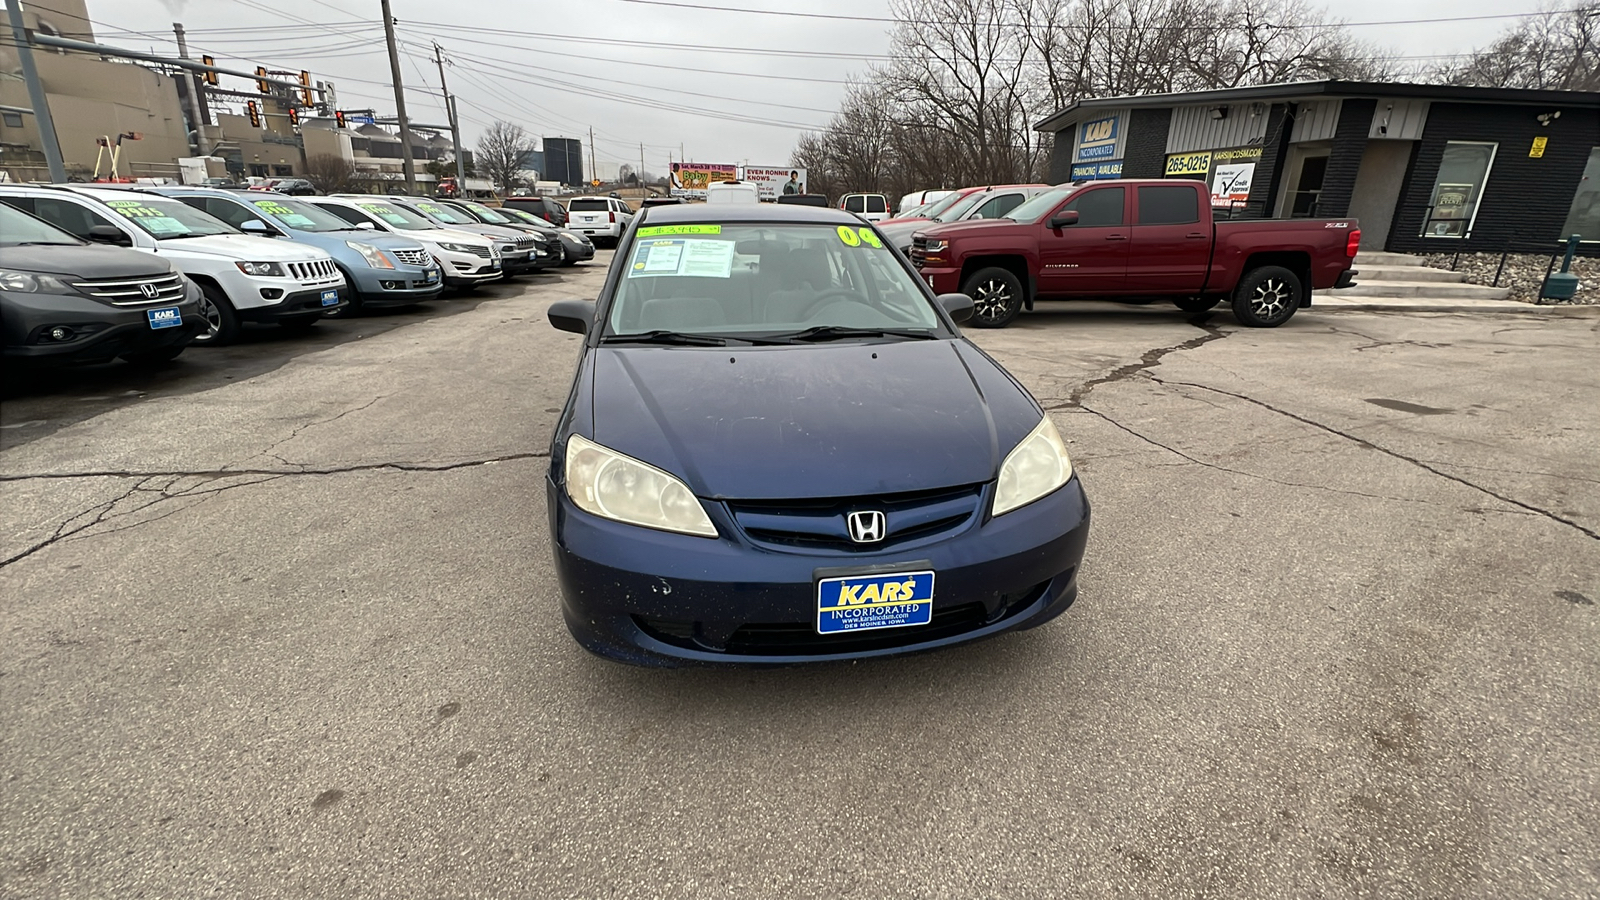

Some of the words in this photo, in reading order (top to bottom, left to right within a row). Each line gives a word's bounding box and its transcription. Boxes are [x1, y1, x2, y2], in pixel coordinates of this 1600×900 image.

[1084, 119, 1114, 142] KARS
[1080, 145, 1114, 157] INCORPORATED
[1073, 166, 1096, 176] FINANCING
[1098, 163, 1123, 175] AVAILABLE
[1167, 154, 1209, 173] 265-0215
[683, 170, 708, 181] Baby
[837, 226, 883, 249] 04
[155, 310, 175, 320] KARS
[837, 580, 917, 606] KARS
[831, 603, 920, 619] INCORPORATED
[842, 612, 909, 624] www.karsincdsm.com
